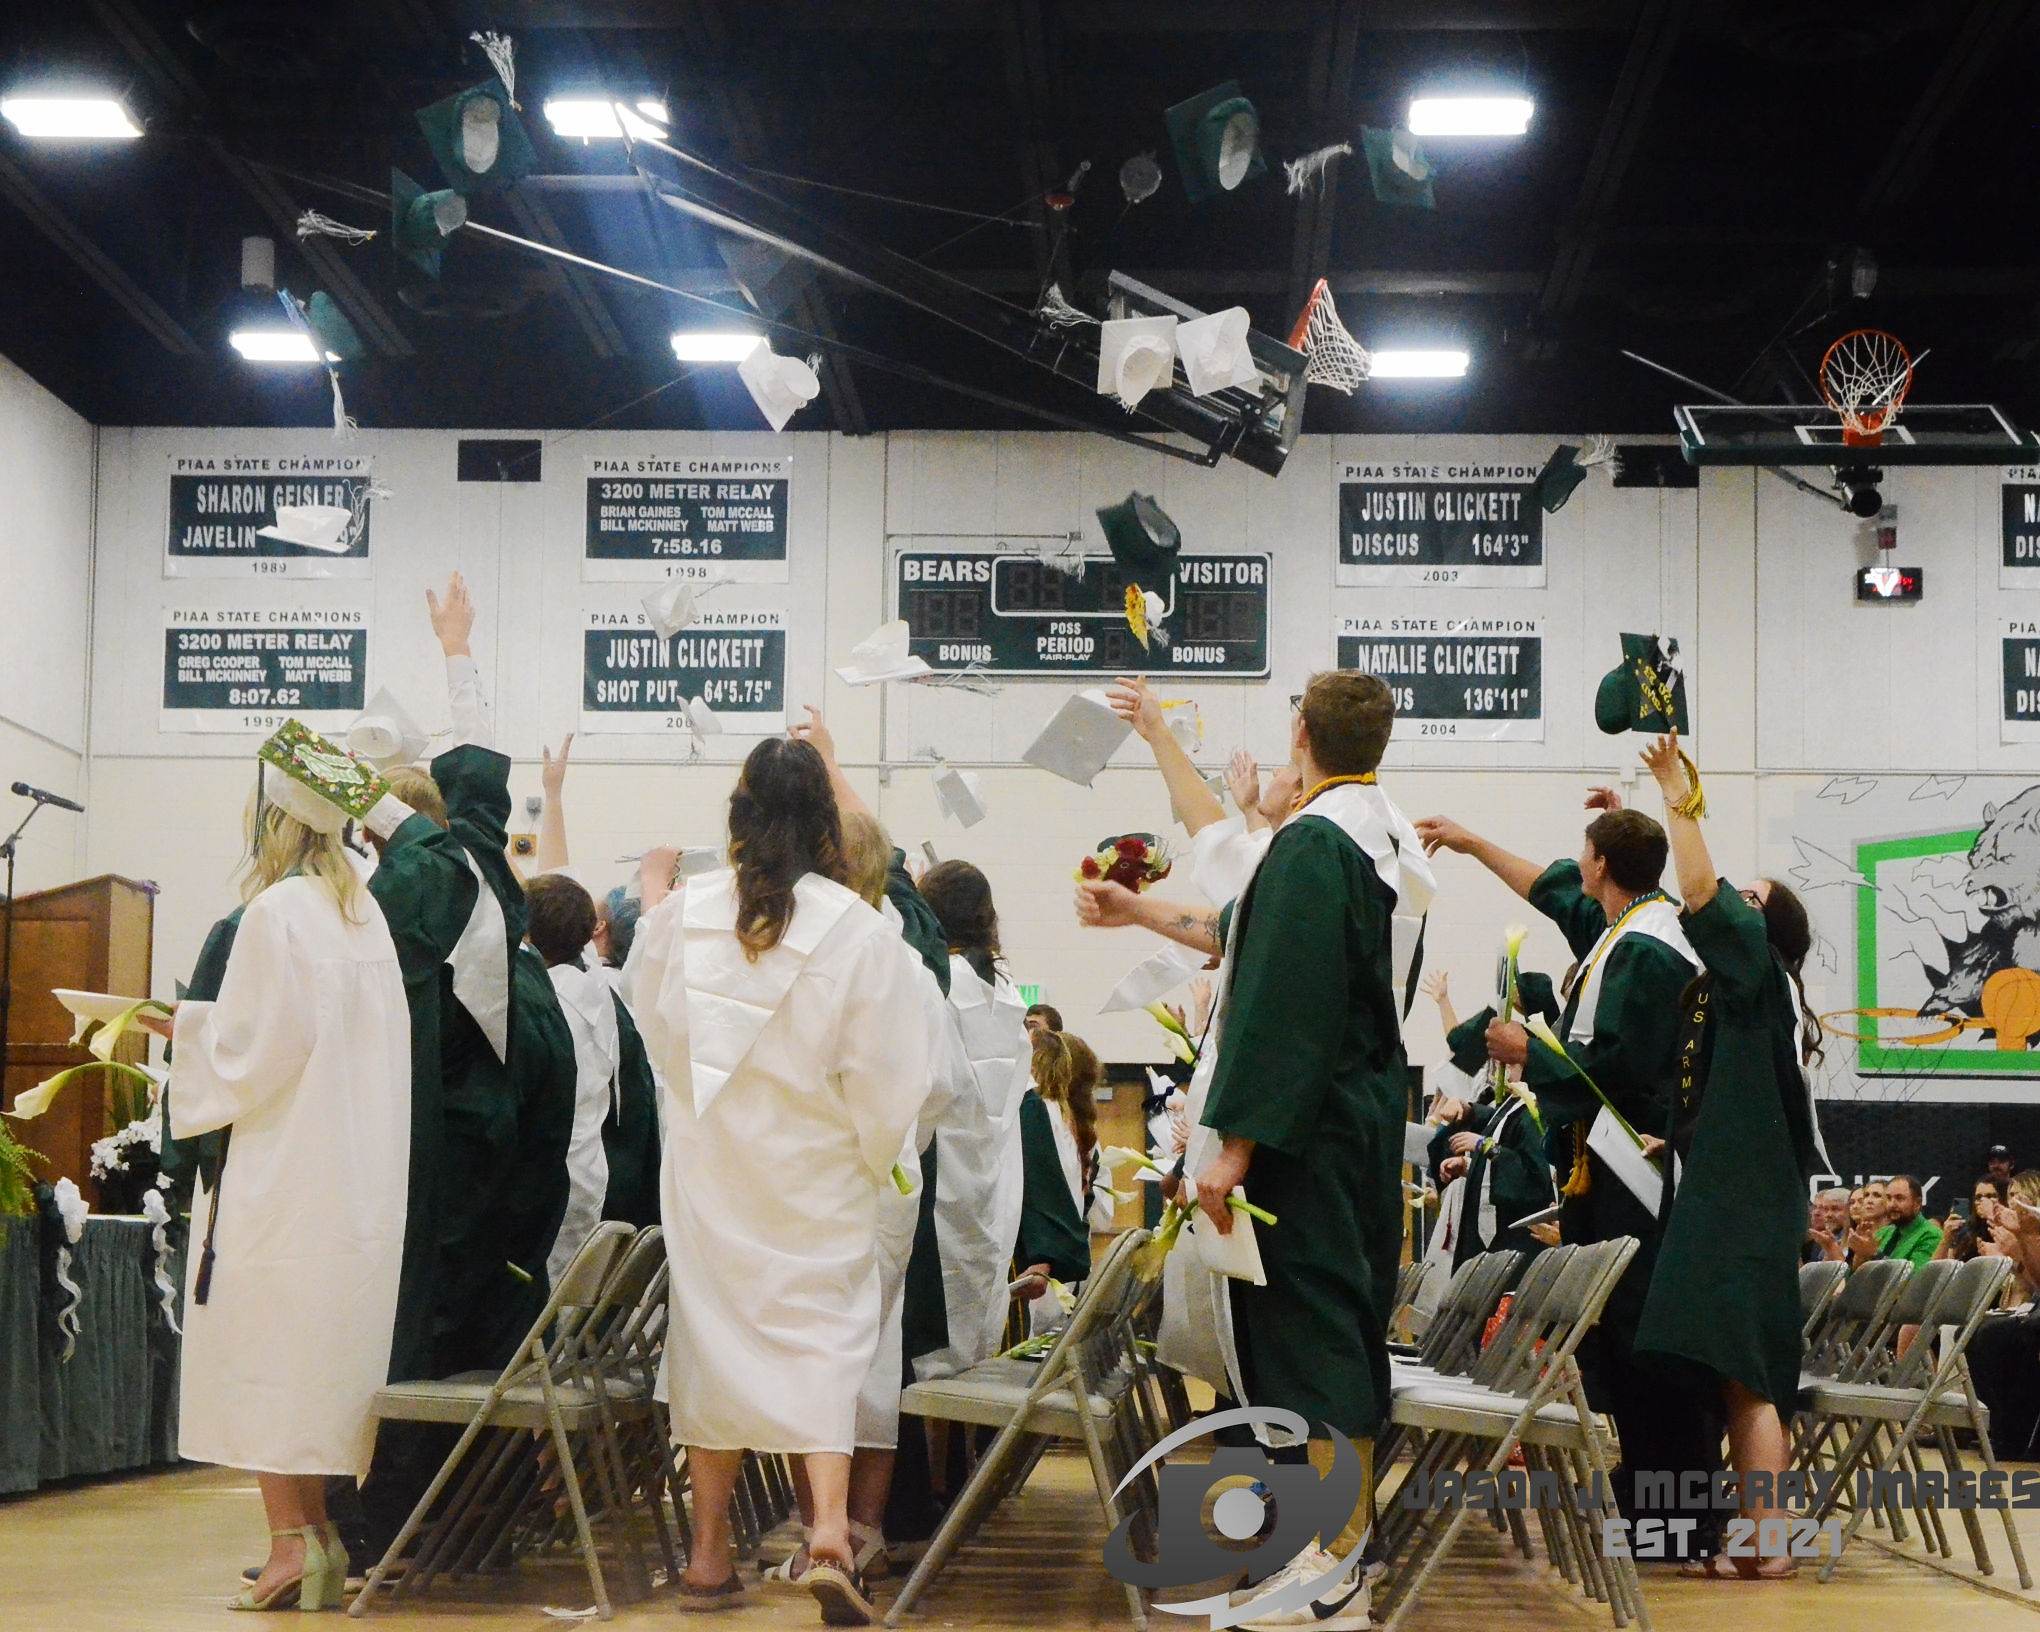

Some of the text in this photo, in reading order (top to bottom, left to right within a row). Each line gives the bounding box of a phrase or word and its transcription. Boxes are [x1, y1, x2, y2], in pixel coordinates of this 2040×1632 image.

[178, 459, 215, 470] PIAA
[224, 459, 270, 470] STATE
[593, 461, 781, 473] PIAA STATE CHAMPIONS
[1346, 466, 1537, 478] PIAA STATE CHAMPION
[197, 484, 265, 513] SHARON
[601, 483, 775, 500] 3200 METER RELAY
[600, 506, 774, 519] BRIAN GAINES TOM MCCALL
[1361, 491, 1521, 522] JUSTIN CLICKETT
[600, 519, 774, 532] BILL MCKINNEY MATT WEBB
[182, 526, 256, 548] JAVELIN
[1352, 533, 1529, 556] DISCUS 164'3"
[652, 538, 722, 554] 7:58.16
[252, 562, 287, 573] 1989
[904, 560, 990, 582] BEARS
[1178, 562, 1264, 584] VISITOR
[173, 611, 209, 623] PIAA
[217, 611, 261, 623] STATE
[591, 614, 629, 624] PIAA
[1344, 619, 1383, 631] PIAA
[1391, 619, 1438, 631] STATE
[1050, 621, 1081, 635] POSS
[178, 634, 353, 650] 3200 METER RELAY
[1037, 636, 1094, 654] PERIOD
[606, 638, 764, 668] JUSTIN CLICKETT
[939, 645, 992, 662] BONUS
[1172, 646, 1225, 663] BONUS
[1358, 644, 1520, 675] NATALIE CLICKETT
[178, 656, 352, 669] GREG COOPER TOM MCCALL
[178, 669, 352, 682] BILL MCKINNEY MATT WEBB
[228, 688, 300, 705] 8:07.62
[597, 679, 678, 703] SHOT PUT
[1464, 687, 1529, 711] 136'11"
[244, 716, 284, 727] 1997
[1421, 724, 1457, 735] 2004
[1681, 992, 1709, 1108] US ARMY
